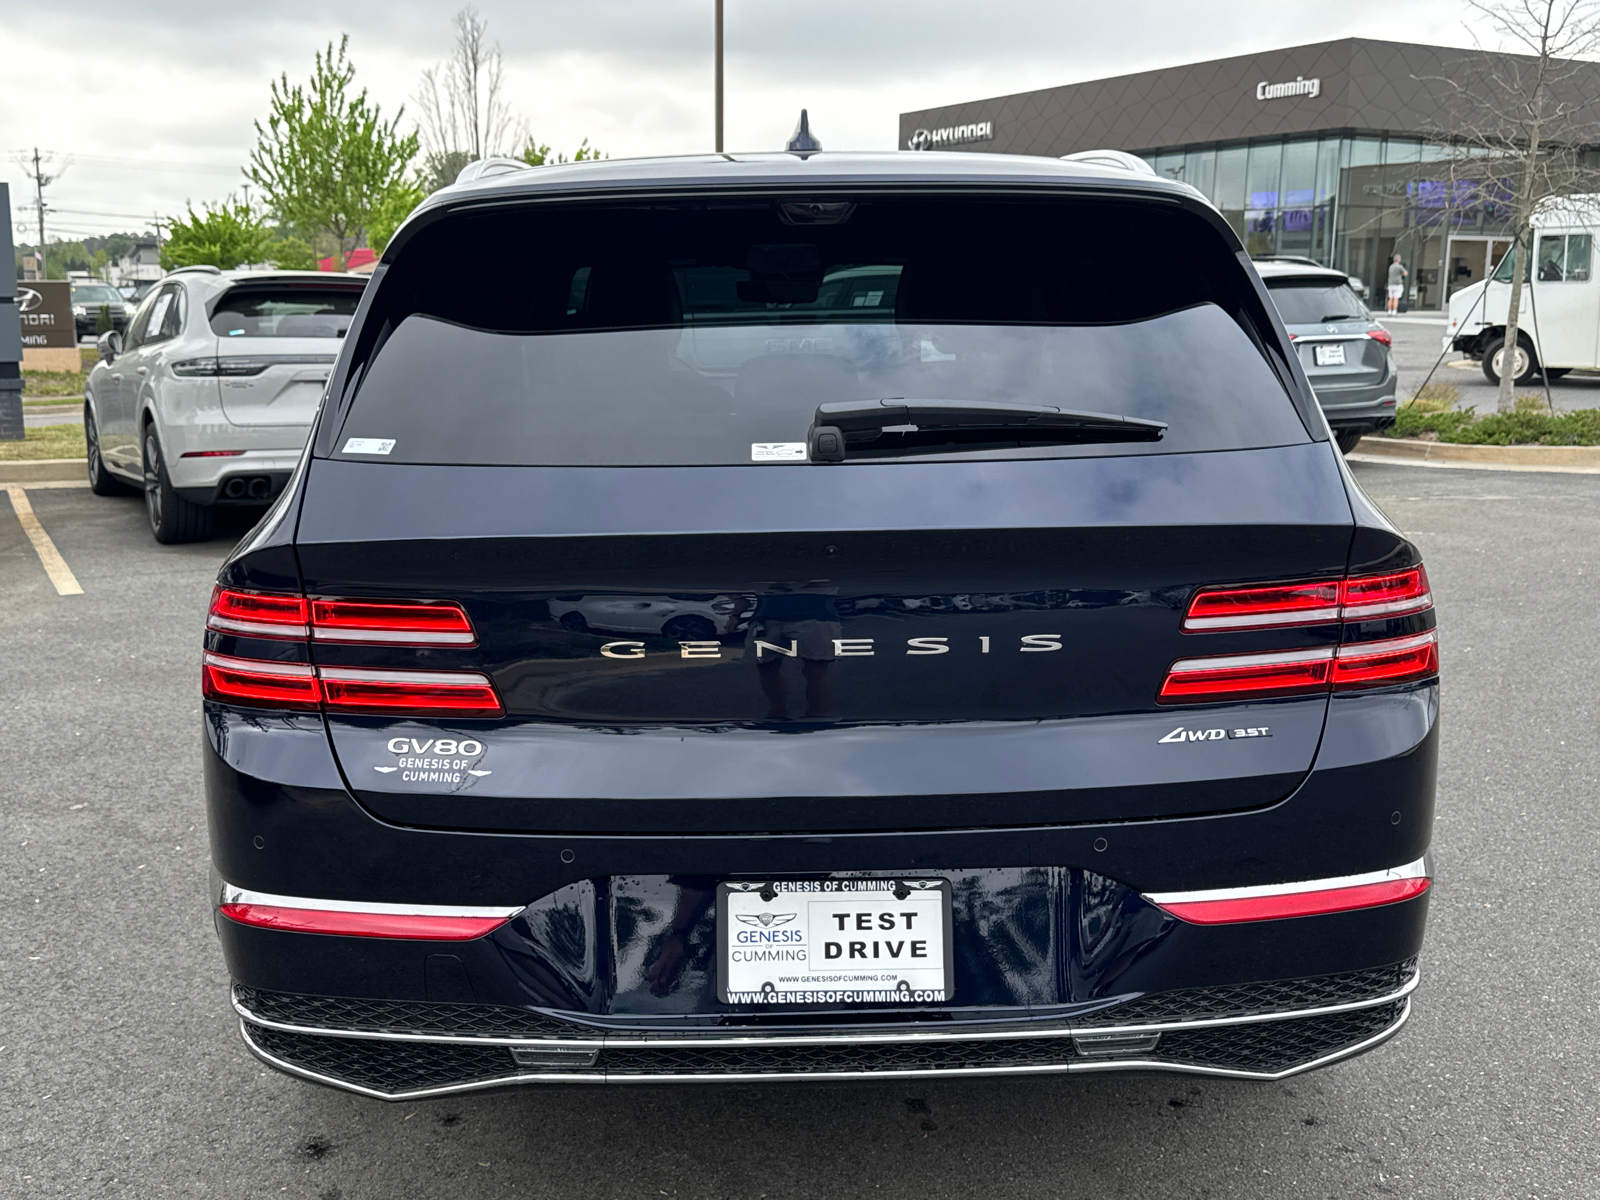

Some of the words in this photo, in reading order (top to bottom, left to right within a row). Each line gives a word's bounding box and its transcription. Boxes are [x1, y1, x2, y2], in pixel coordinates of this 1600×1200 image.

[1256, 76, 1320, 100] Cumming
[932, 121, 992, 143] HYUNDAI
[599, 634, 1063, 659] GENESIS
[387, 737, 483, 756] GV80
[398, 757, 450, 770] GENESIS
[452, 759, 469, 770] OF
[402, 770, 461, 783] CUMMING
[773, 881, 821, 892] GENESIS
[824, 881, 839, 892] OF
[842, 880, 896, 892] CUMMING
[832, 912, 918, 931] TEST
[736, 930, 803, 943] GENESIS
[732, 949, 807, 962] CUMMING
[824, 940, 928, 959] DRIVE
[778, 974, 898, 983] WWW.GENESISOFCUMMING.COM
[727, 990, 946, 1004] WWW.GENESISOFCUMMING.COM
